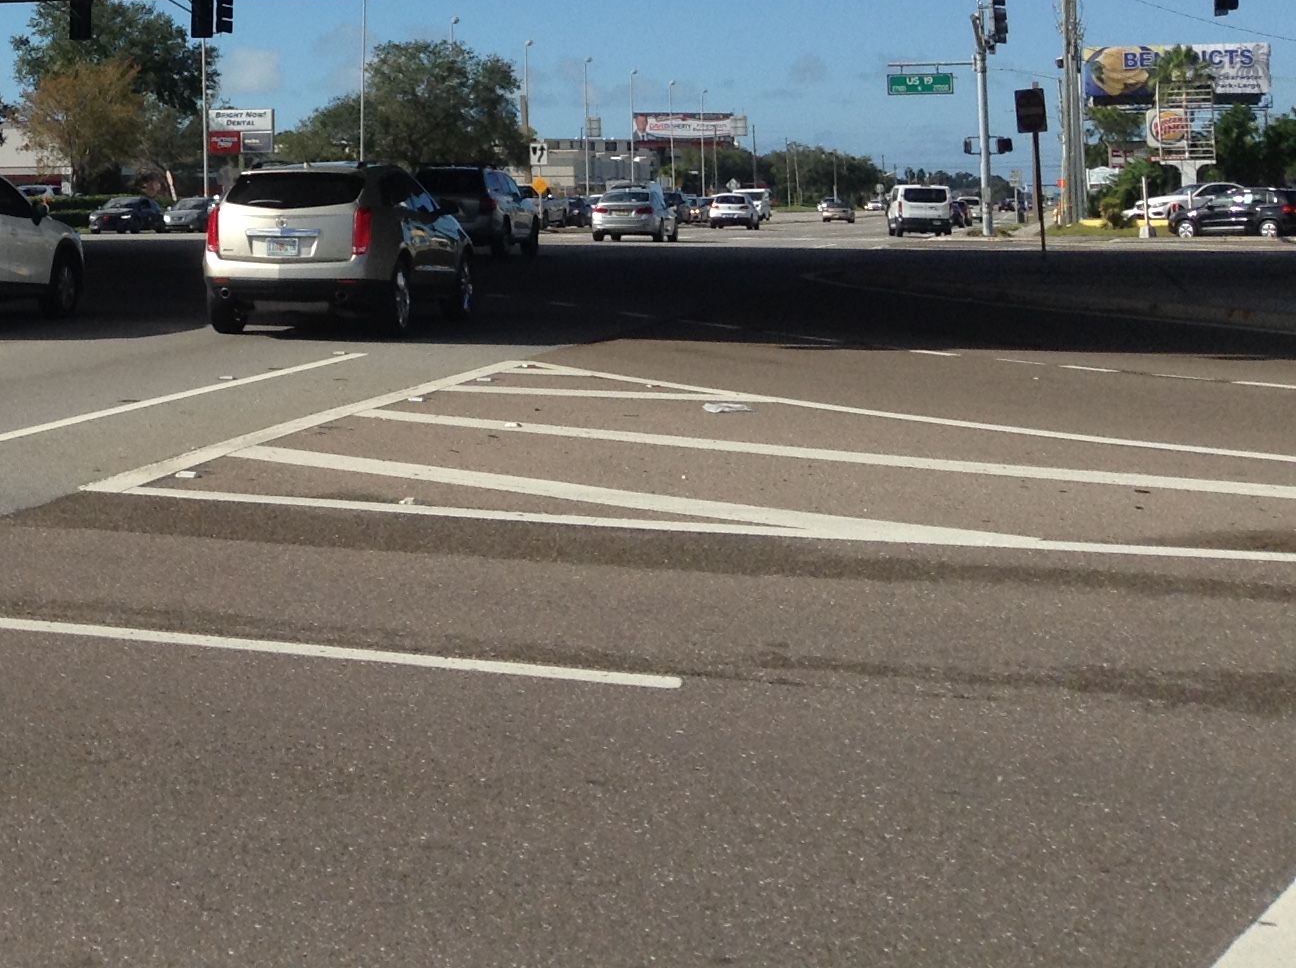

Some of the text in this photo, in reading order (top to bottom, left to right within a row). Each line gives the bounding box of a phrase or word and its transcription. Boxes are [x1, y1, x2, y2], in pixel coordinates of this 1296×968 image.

[906, 76, 934, 86] US 19
[226, 119, 256, 127] DENTAL
